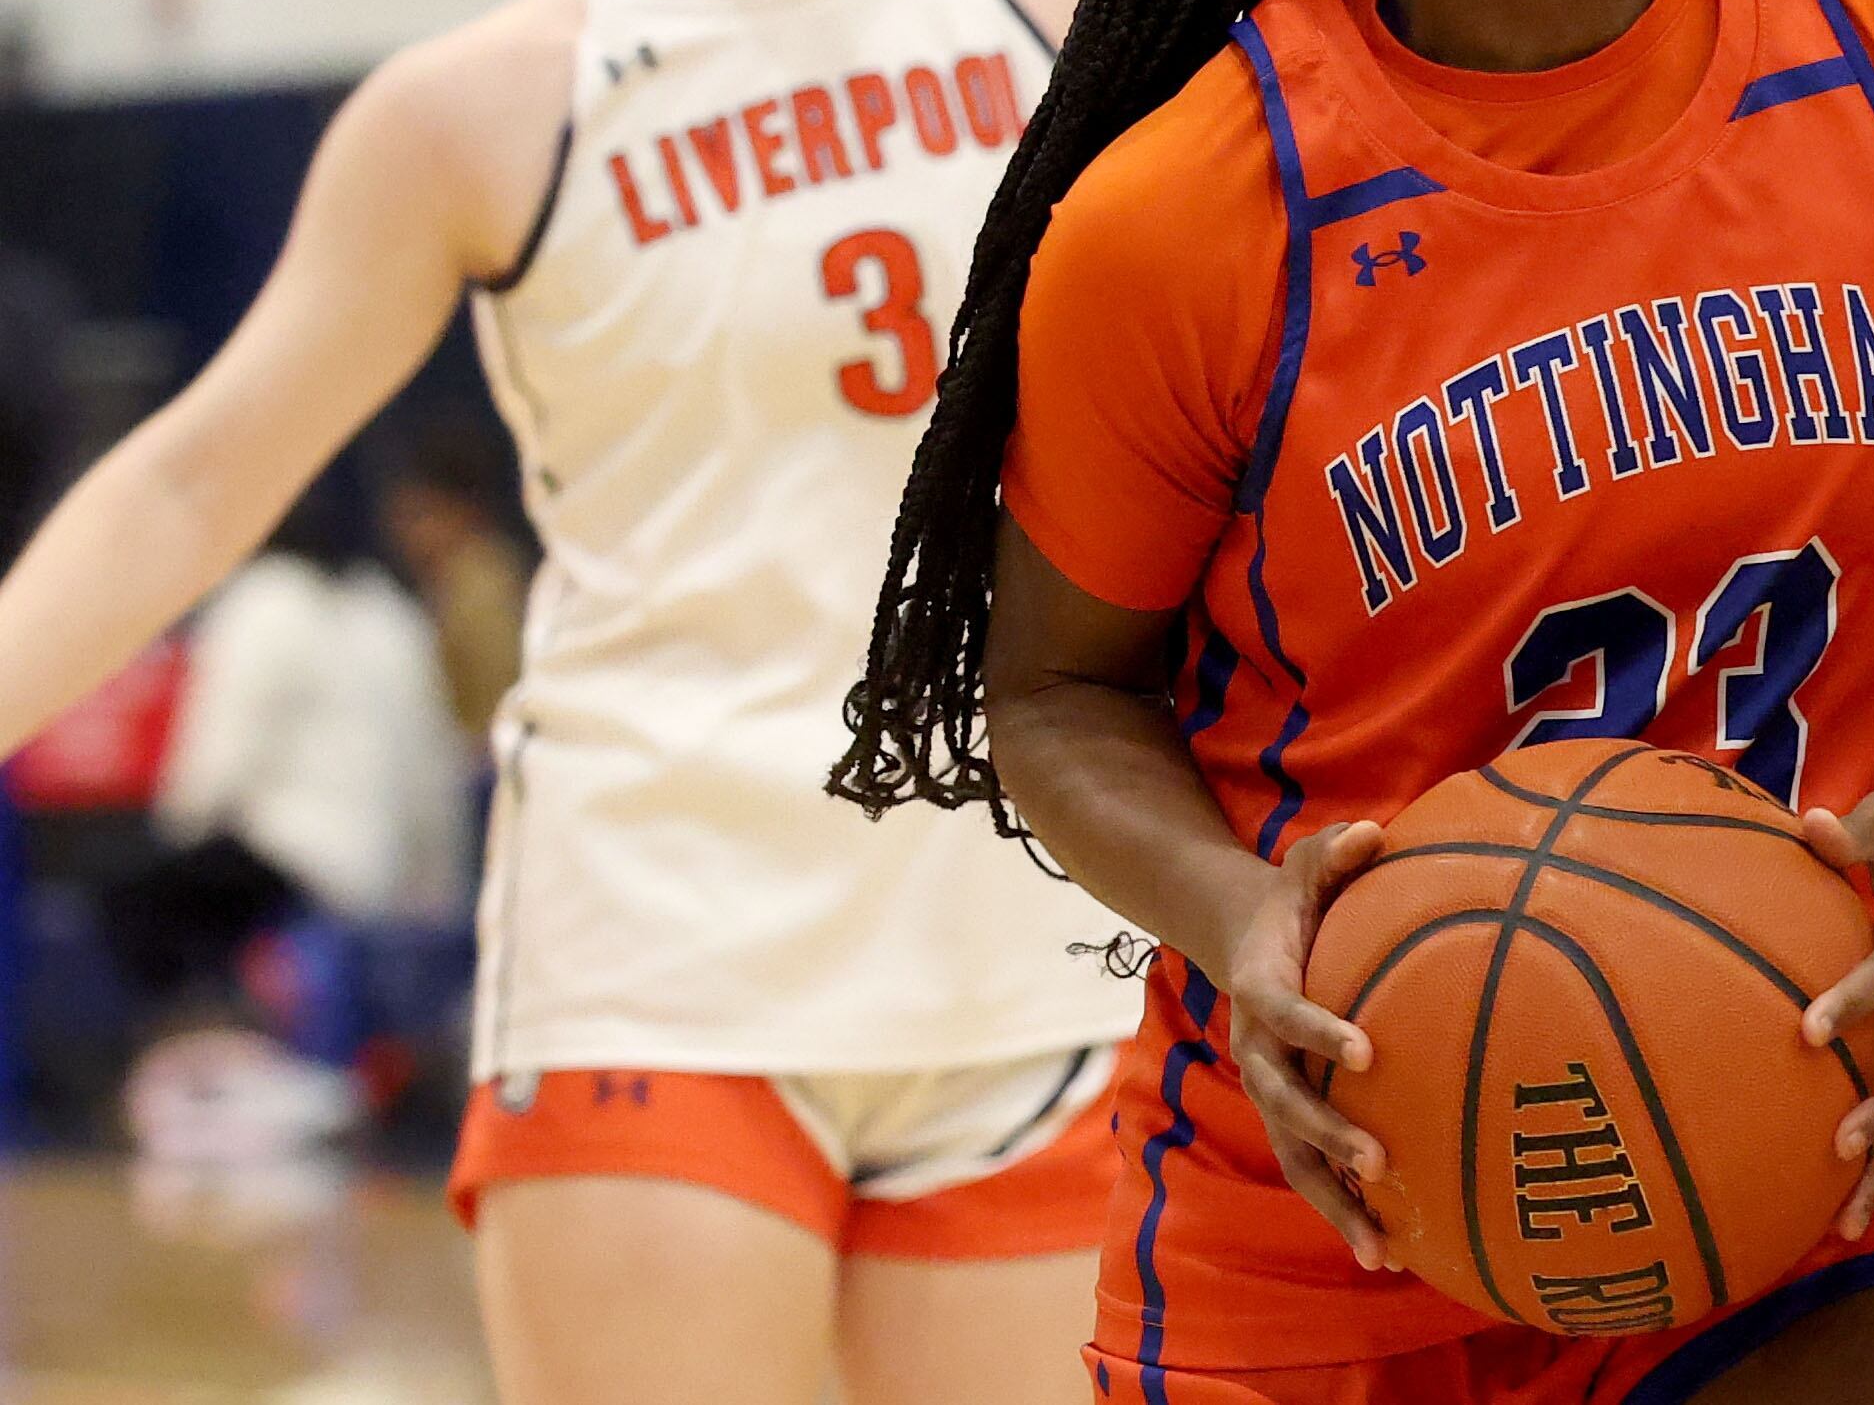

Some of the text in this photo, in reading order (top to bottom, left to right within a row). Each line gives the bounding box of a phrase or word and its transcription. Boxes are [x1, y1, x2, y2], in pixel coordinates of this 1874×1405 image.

[819, 226, 940, 419] 3
[1503, 536, 1842, 811] 23
[1511, 1061, 1653, 1242] THE
